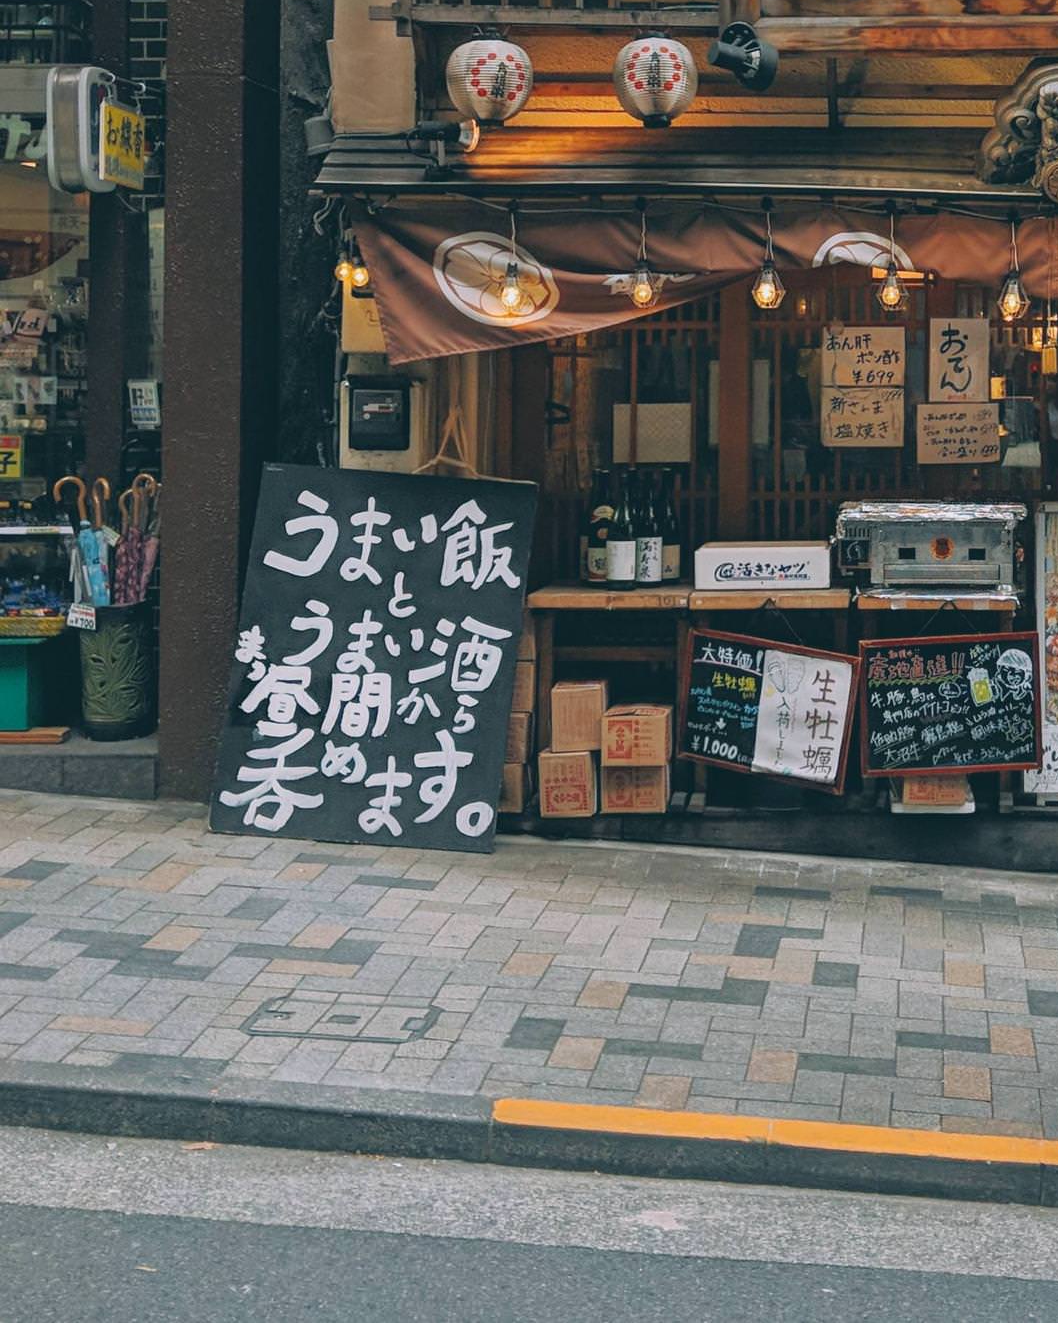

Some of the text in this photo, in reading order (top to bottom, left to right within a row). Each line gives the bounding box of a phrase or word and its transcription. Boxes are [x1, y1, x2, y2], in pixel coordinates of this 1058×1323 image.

[940, 323, 972, 393] おでん
[263, 490, 520, 590] うまい飯
[388, 571, 416, 618] と
[282, 599, 512, 692] うまい酒
[800, 669, 838, 778] 生牡蠣
[220, 728, 493, 838] 呑めます。
